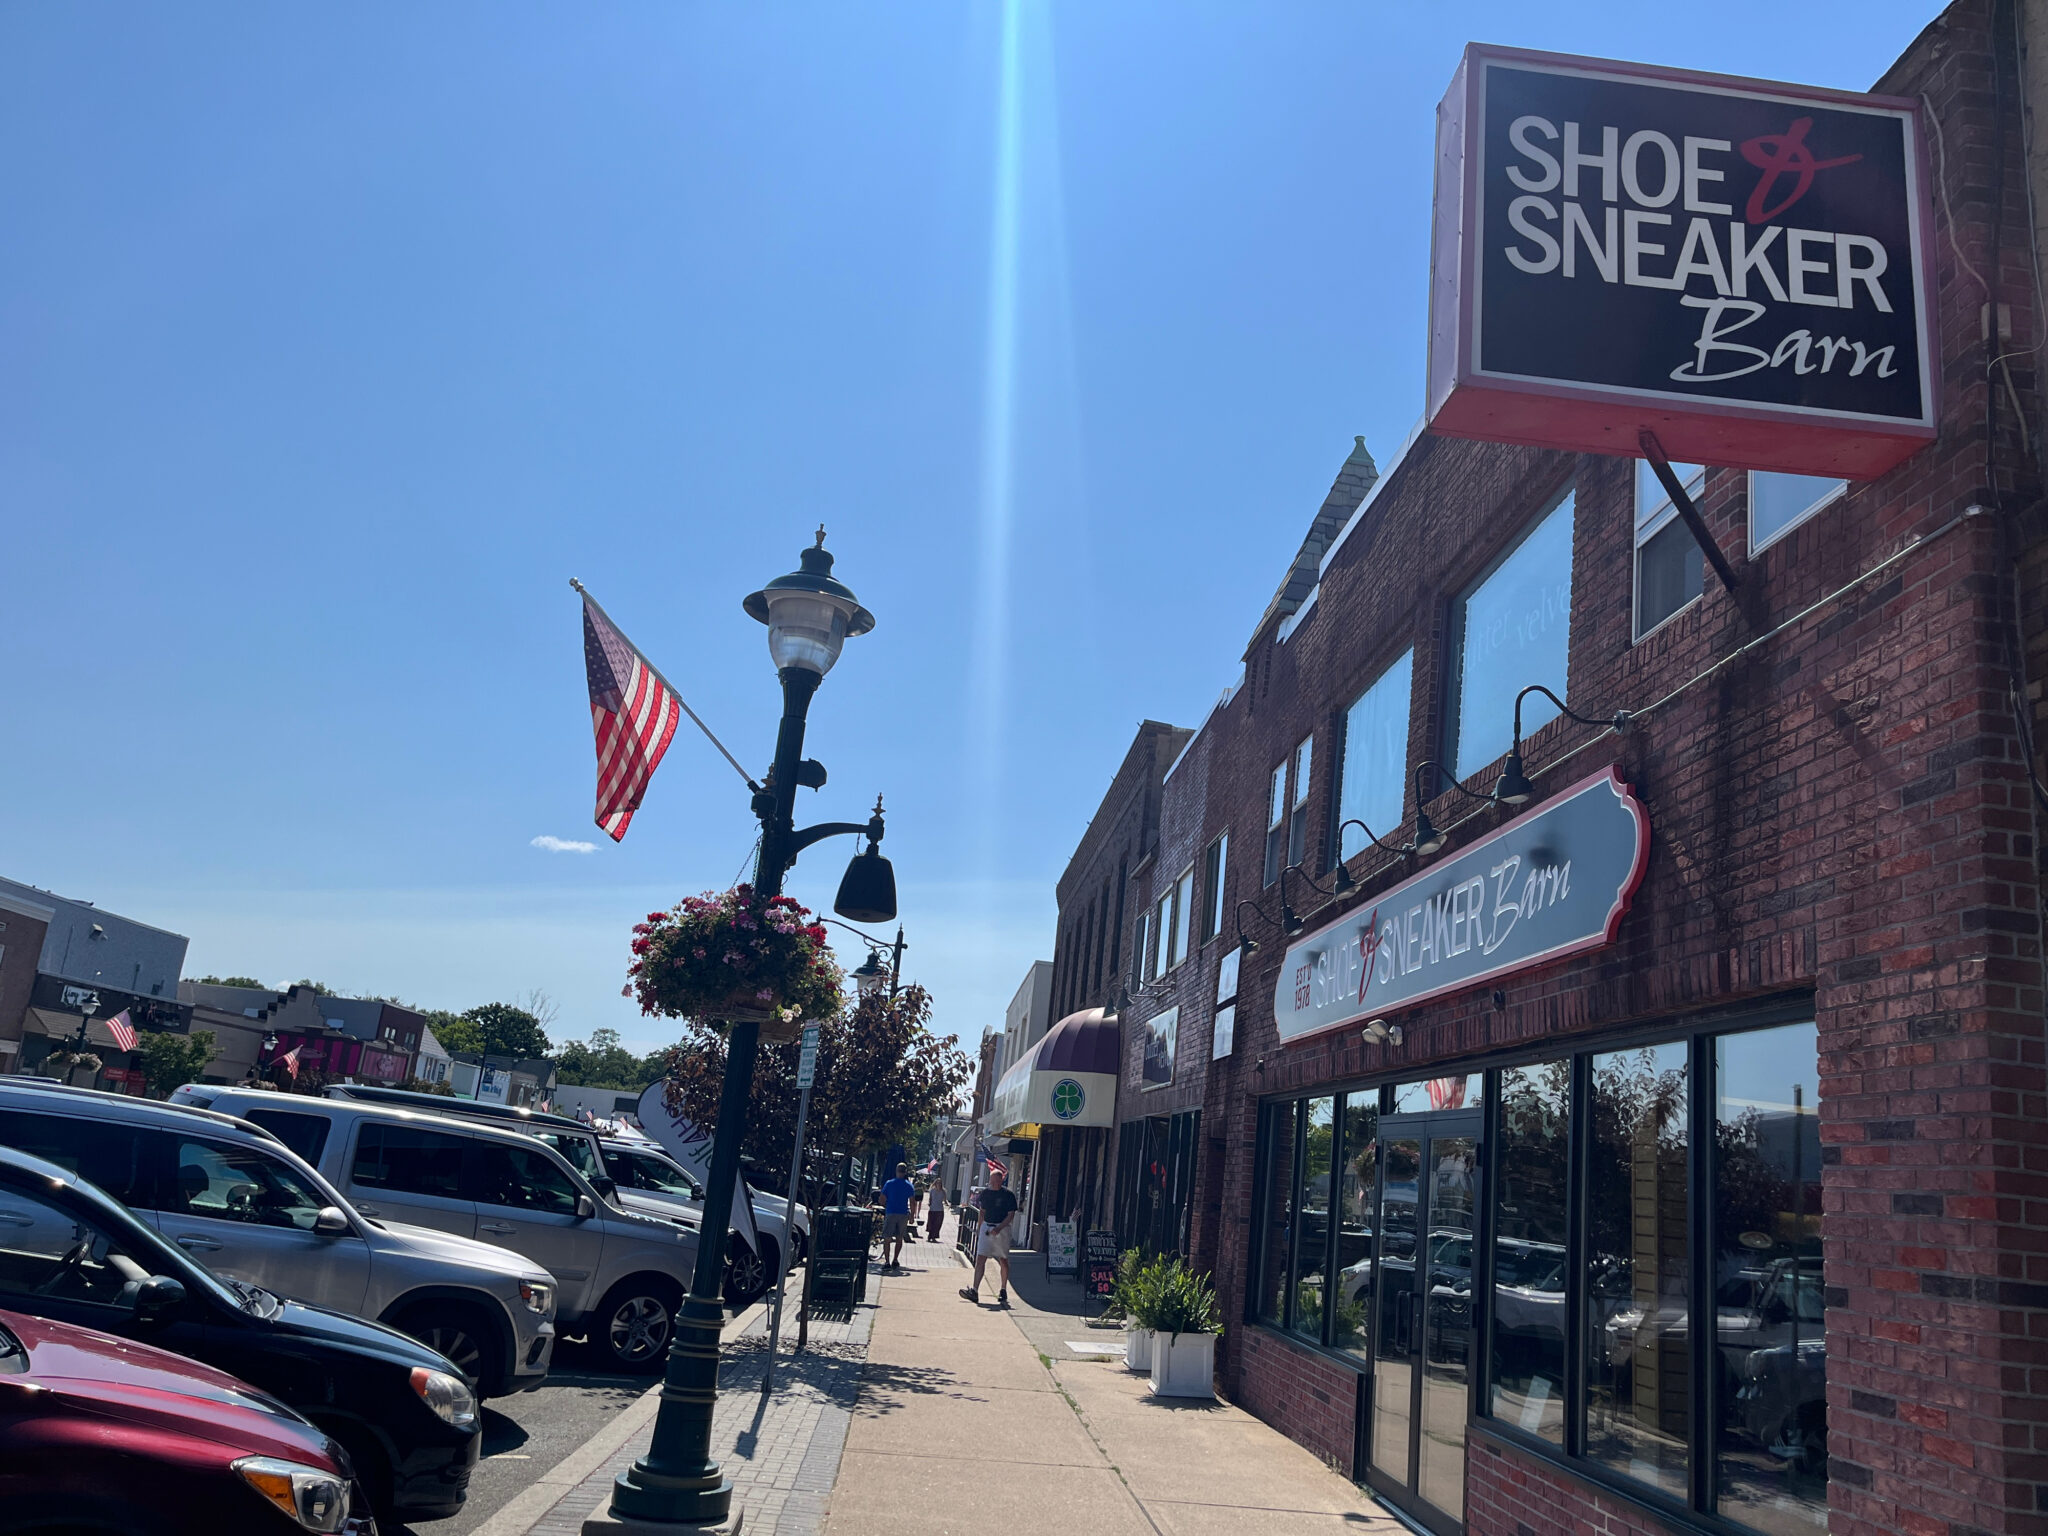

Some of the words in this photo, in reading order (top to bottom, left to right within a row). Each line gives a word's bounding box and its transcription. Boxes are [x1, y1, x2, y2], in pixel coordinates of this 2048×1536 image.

[1504, 115, 1733, 216] SHOE
[1504, 196, 1894, 313] SNEAKER
[1669, 294, 1898, 383] Barn
[1316, 935, 1360, 1008] SHOE
[1378, 874, 1484, 985] SNEAKER
[1482, 855, 1572, 956] Barn
[1295, 984, 1311, 1011] 1978
